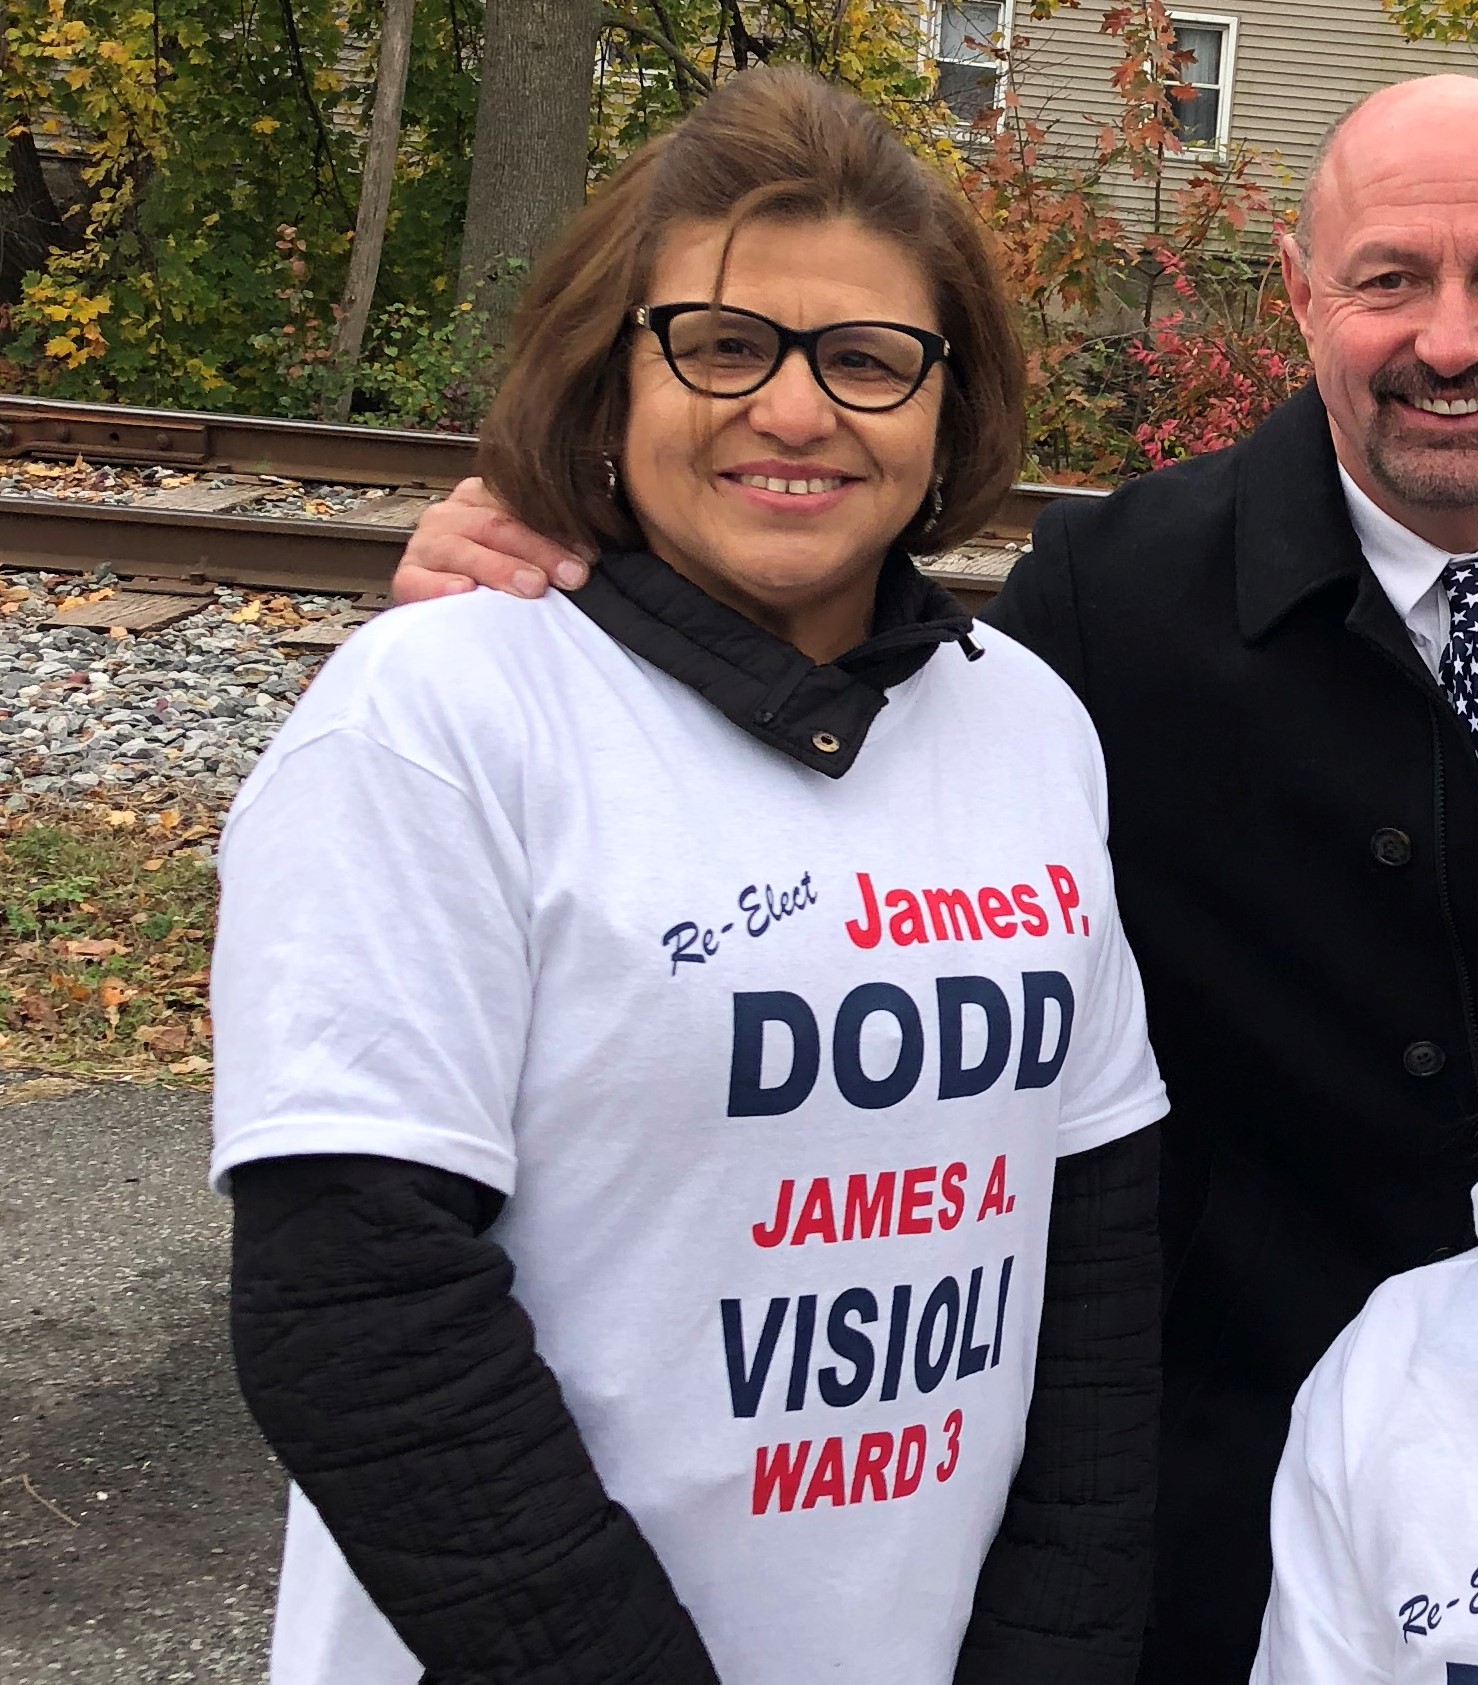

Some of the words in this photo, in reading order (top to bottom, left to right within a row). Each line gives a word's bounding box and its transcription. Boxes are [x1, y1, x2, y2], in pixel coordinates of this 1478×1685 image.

[663, 871, 818, 975] Re-Elect
[845, 872, 1049, 949] James
[1045, 864, 1089, 937] P.
[727, 971, 1075, 1117] DODD
[752, 1161, 967, 1249] JAMES
[977, 1155, 1016, 1222] A.
[720, 1256, 1015, 1418] VISIOLI
[751, 1424, 927, 1515] WARD
[936, 1409, 963, 1483] 3
